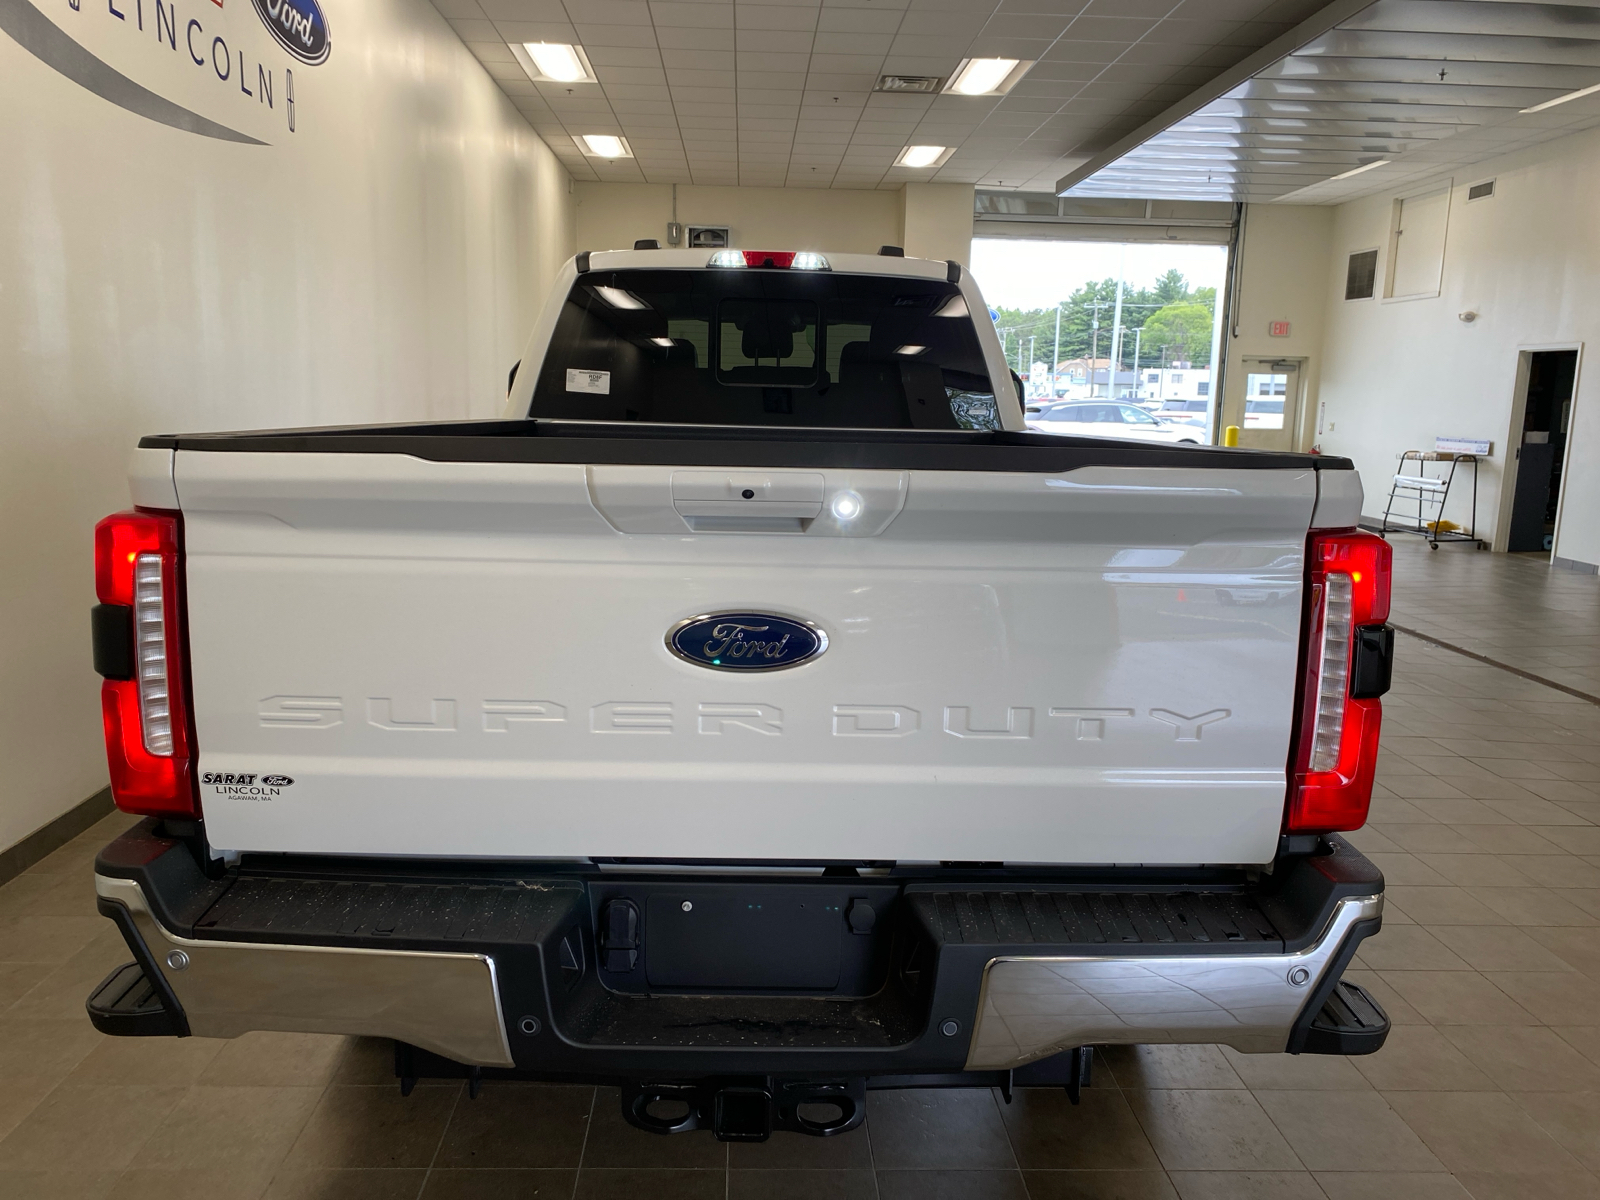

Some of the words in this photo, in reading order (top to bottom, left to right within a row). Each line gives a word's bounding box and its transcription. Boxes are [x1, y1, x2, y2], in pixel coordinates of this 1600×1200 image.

[1273, 322, 1289, 335] EXIT
[703, 623, 791, 659] Ford
[259, 695, 784, 736] SUPER
[832, 703, 1232, 742] DUTY
[201, 772, 258, 787] SARAT
[267, 776, 288, 786] Ford
[215, 786, 280, 796] LINCOLN
